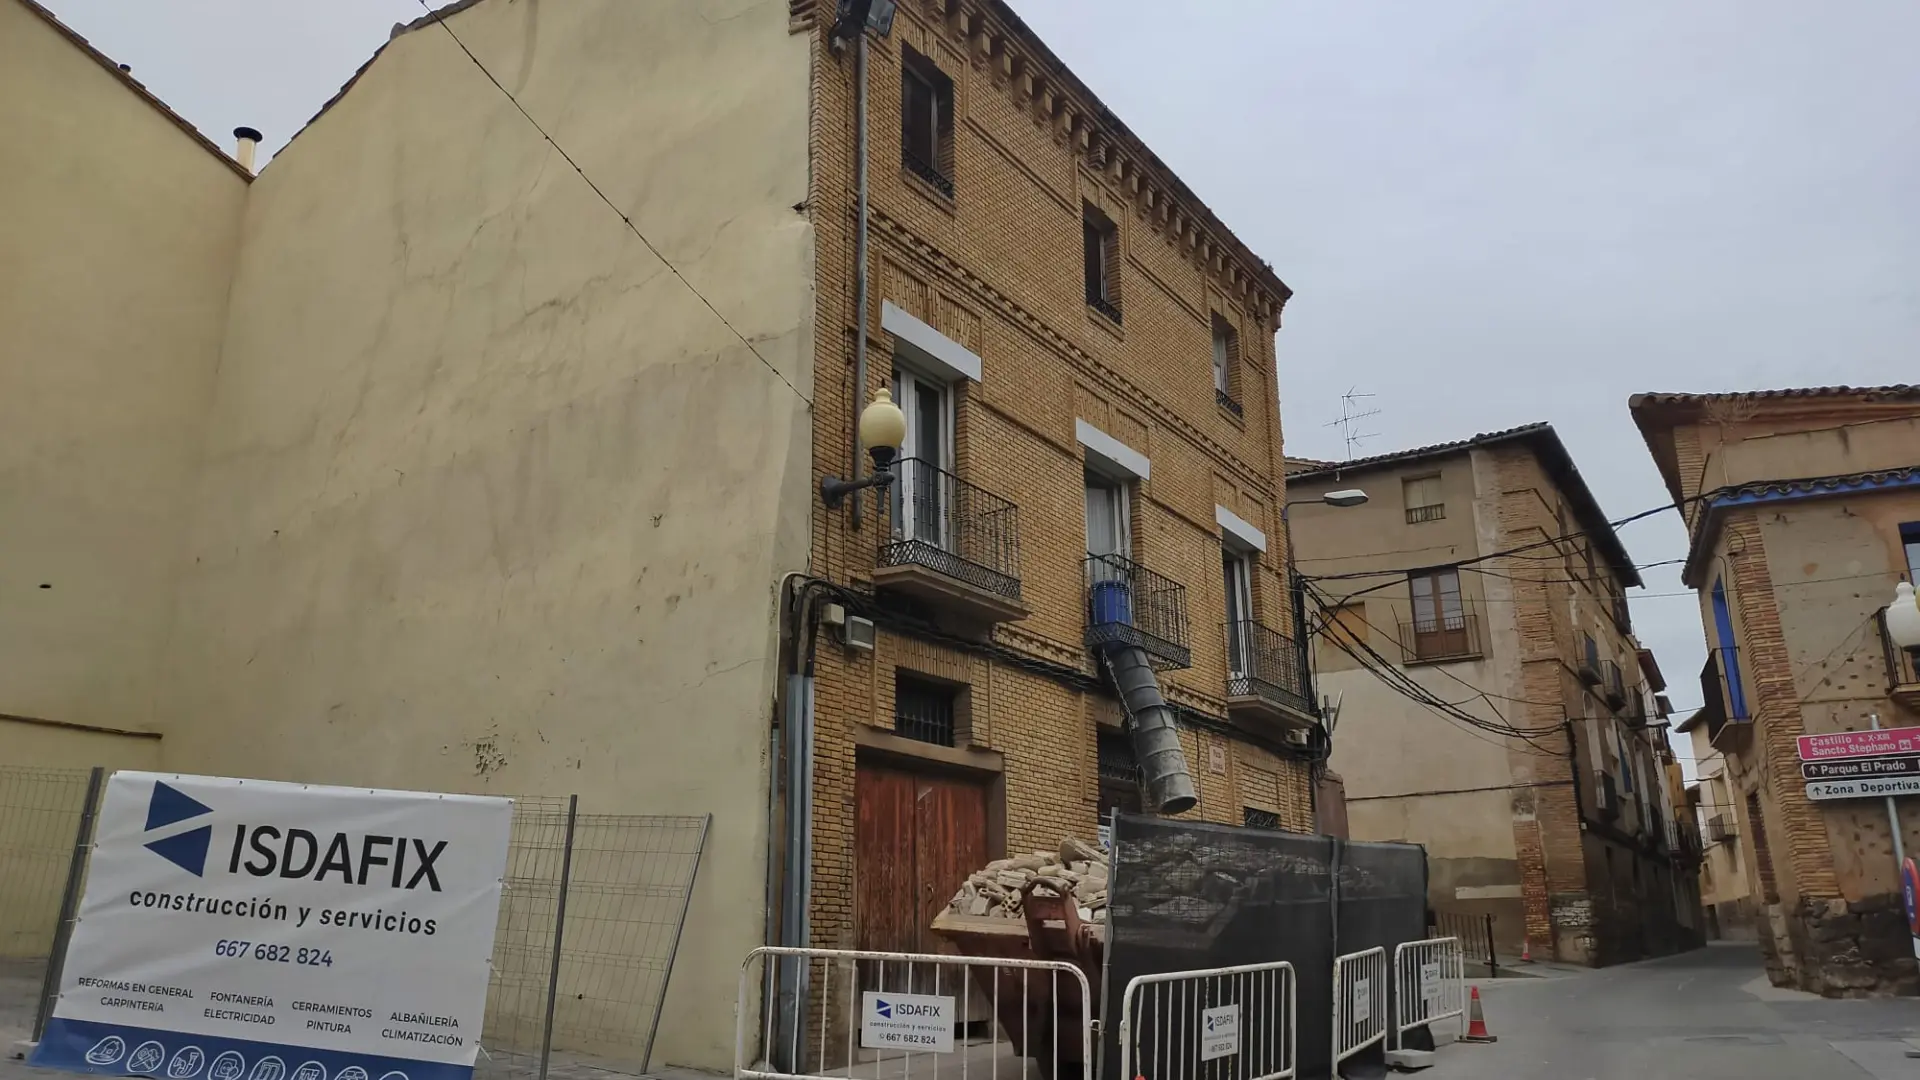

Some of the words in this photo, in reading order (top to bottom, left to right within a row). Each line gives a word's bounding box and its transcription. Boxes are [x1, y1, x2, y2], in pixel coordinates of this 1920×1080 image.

[1809, 735, 1852, 746] Castillo
[1811, 746, 1847, 756] Sancto
[1848, 742, 1896, 754] Stephano
[1820, 763, 1859, 775] Parque
[1860, 762, 1872, 772] El
[1873, 760, 1907, 771] Prado
[1824, 785, 1855, 795] Zona
[1860, 780, 1920, 793] Deportiva
[228, 823, 449, 892] ISDAFIX
[129, 890, 288, 921] construcción
[296, 906, 311, 928] y
[319, 908, 437, 936] servicios
[215, 939, 250, 959] 667
[254, 943, 290, 963] 682
[296, 948, 333, 967] 824
[78, 977, 130, 992] REFORMAS
[132, 983, 146, 993] EN
[148, 985, 194, 999] GENERAL
[210, 991, 274, 1008] FONTANERÍA
[203, 1008, 276, 1025] ELECTRICIDAD
[291, 1000, 373, 1018] CERRAMIENTOS
[895, 1003, 940, 1017] ISDAFIX
[306, 1020, 351, 1034] PINTURA
[389, 1012, 459, 1028] ALBAÑILERÍA
[381, 1028, 463, 1047] CLIMATIZACIÓN
[886, 1033, 901, 1042] 667
[903, 1034, 919, 1043] 682
[921, 1035, 936, 1044] 824
